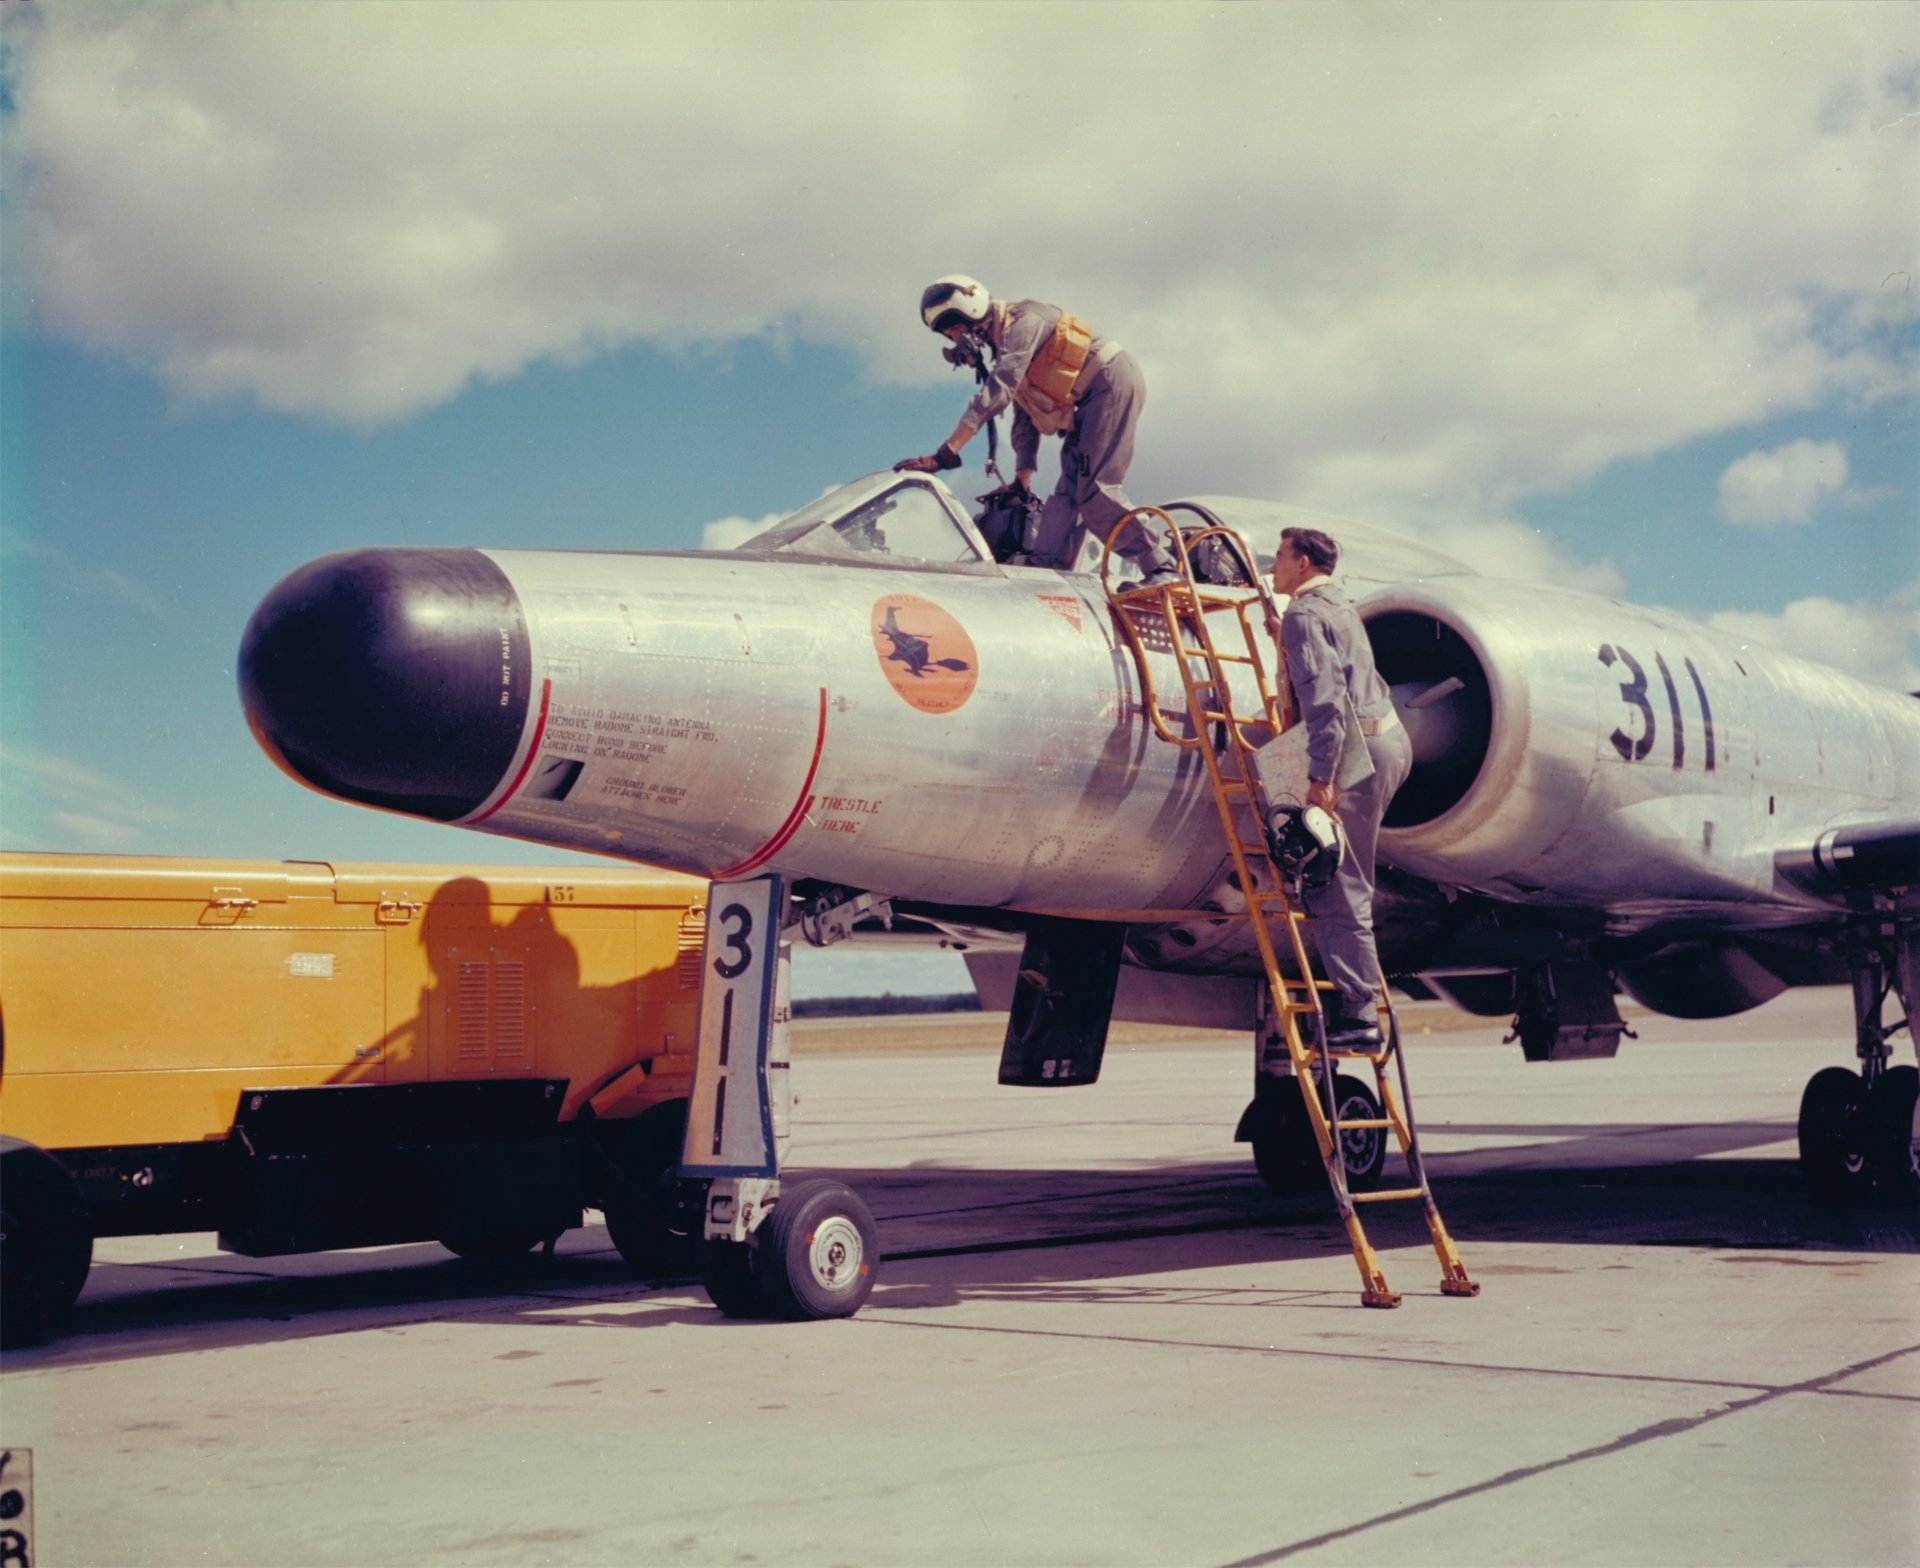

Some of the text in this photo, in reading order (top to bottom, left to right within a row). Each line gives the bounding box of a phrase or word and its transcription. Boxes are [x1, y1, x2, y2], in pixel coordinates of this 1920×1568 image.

[500, 627, 511, 659] PAINT
[502, 665, 511, 685] NOT
[1598, 643, 1715, 771] 311
[548, 714, 588, 729] REMOVE
[594, 720, 634, 734] RADOME
[640, 725, 690, 739] STRAIGHT
[609, 711, 662, 725] DAMAGING
[667, 718, 710, 731] ANTENNA
[542, 739, 589, 754] LOCKING
[545, 728, 592, 743] CONNECT
[629, 741, 668, 755] BEFORE
[606, 776, 645, 790] GROUND
[820, 796, 882, 814] TRESTLE
[822, 819, 860, 833] HERE
